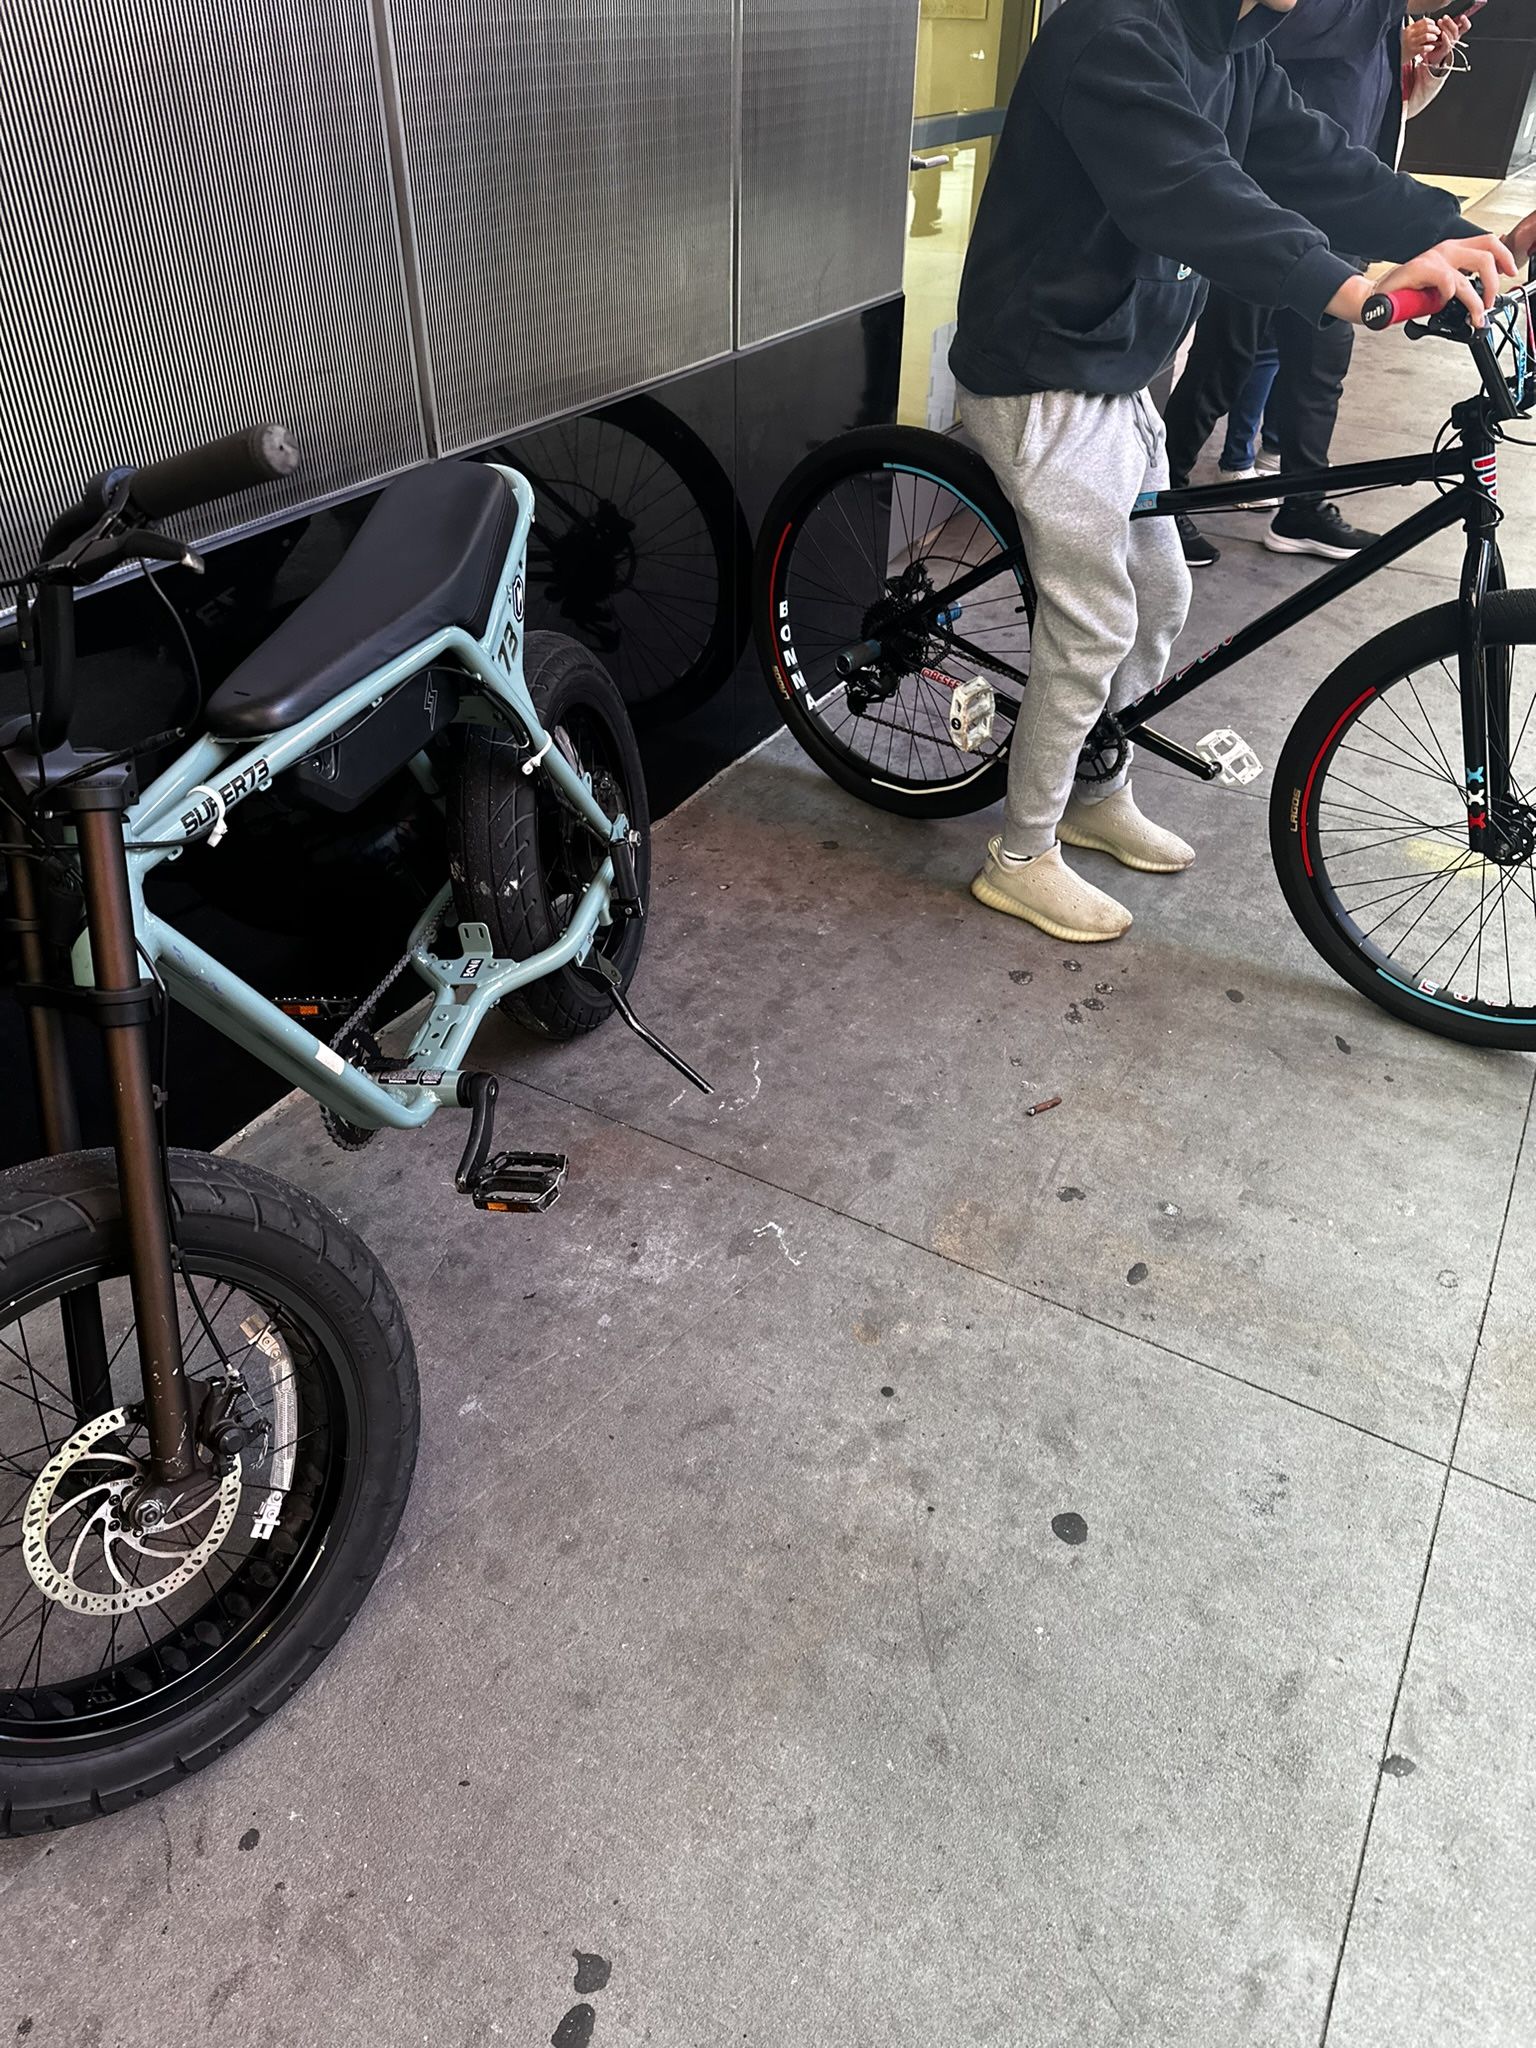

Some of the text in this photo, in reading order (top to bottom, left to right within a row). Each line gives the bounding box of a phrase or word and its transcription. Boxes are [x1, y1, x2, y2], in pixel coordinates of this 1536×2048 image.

[497, 620, 518, 675] 73
[779, 600, 817, 711] BONNA
[1290, 788, 1301, 833] LAGOS
